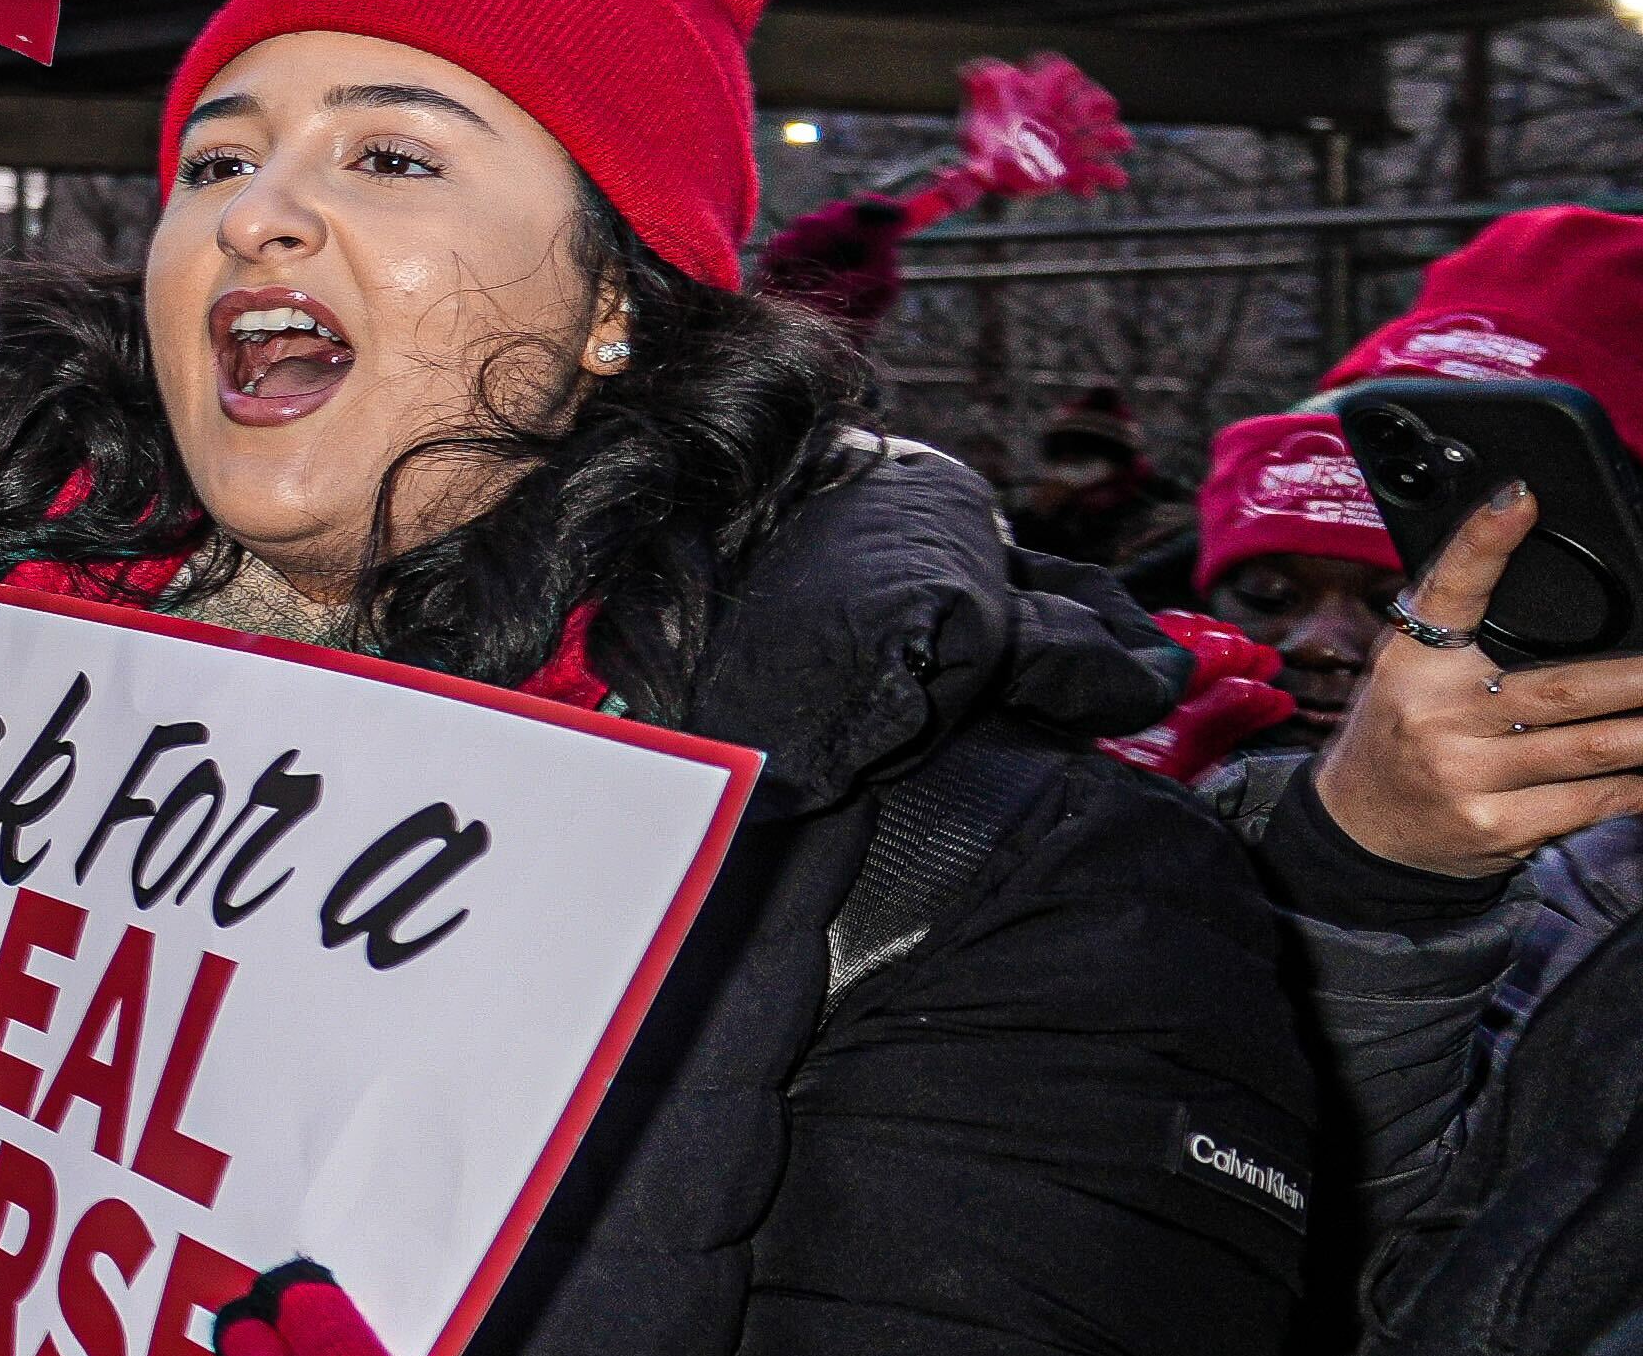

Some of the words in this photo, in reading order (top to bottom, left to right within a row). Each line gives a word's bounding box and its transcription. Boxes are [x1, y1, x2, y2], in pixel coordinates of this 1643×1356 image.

[319, 802, 492, 968] a
[1191, 1134, 1265, 1190] Calvin
[1265, 1167, 1304, 1210] Klein
